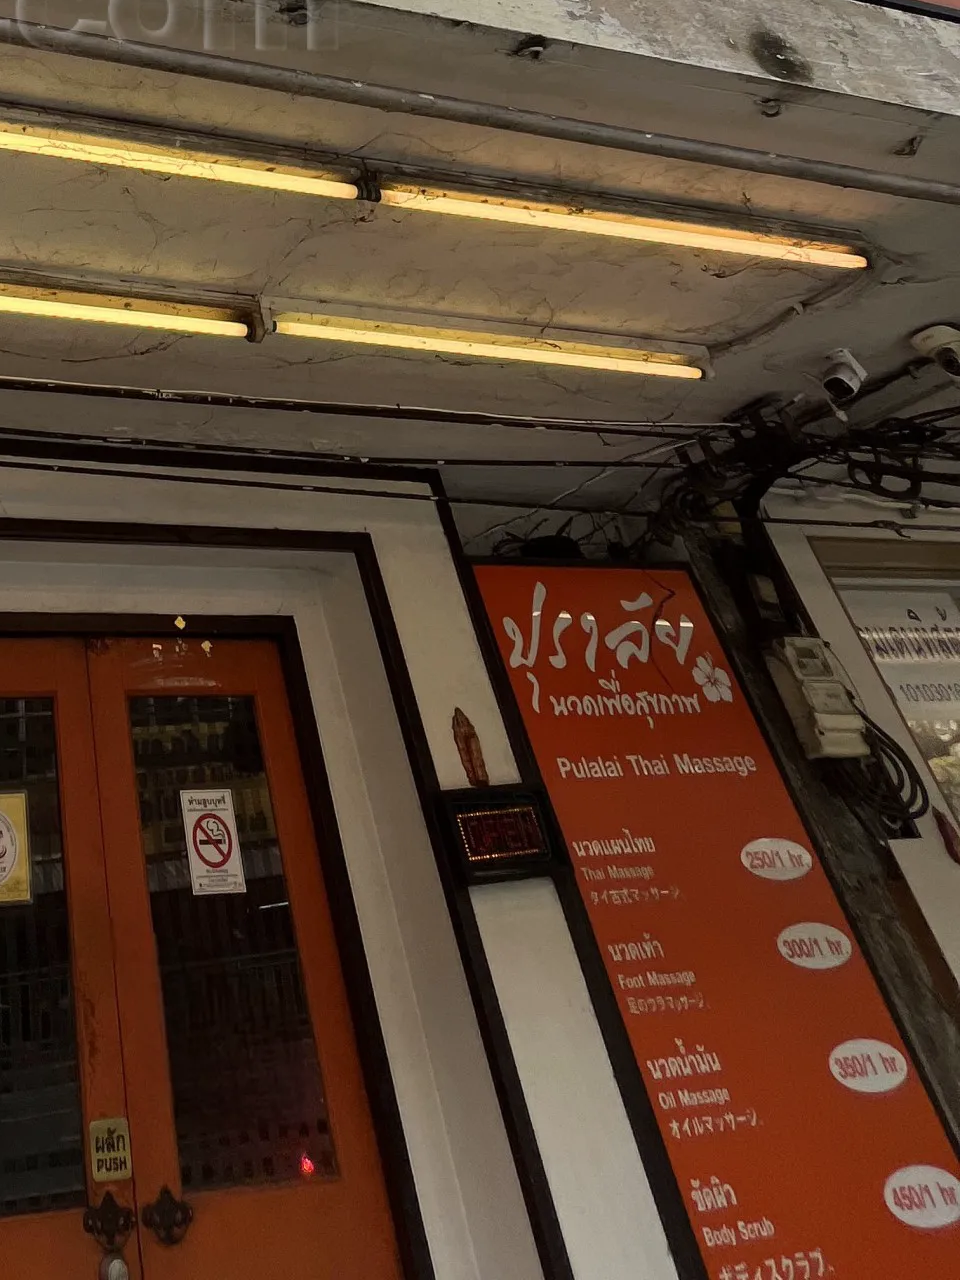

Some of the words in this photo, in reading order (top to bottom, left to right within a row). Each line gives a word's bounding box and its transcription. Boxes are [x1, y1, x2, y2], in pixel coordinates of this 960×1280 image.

[549, 670, 702, 729] นวดเพื่อสุขภาพ
[556, 756, 624, 779] Pulalai
[626, 754, 671, 776] Thai
[673, 753, 757, 778] Massage
[572, 827, 656, 857] นวดแผนไทย
[580, 867, 605, 881] Thai
[607, 864, 655, 880] Massage
[746, 850, 785, 870] 250/1
[607, 932, 665, 962] นวดเท้า
[782, 937, 823, 959] 300/1
[617, 974, 645, 990] Foot
[646, 970, 696, 987] Massage
[646, 1037, 722, 1080] นวดน้ำมัน
[834, 1052, 878, 1080] 350/1
[658, 1091, 677, 1110] Oil
[677, 1088, 731, 1107] Massage
[95, 1127, 126, 1154] ผลัก
[96, 1156, 128, 1173] PUSH
[690, 1175, 737, 1212] ขัดผิว
[892, 1183, 937, 1211] 450/1
[702, 1224, 737, 1247] Body
[736, 1217, 775, 1241] Scrub
